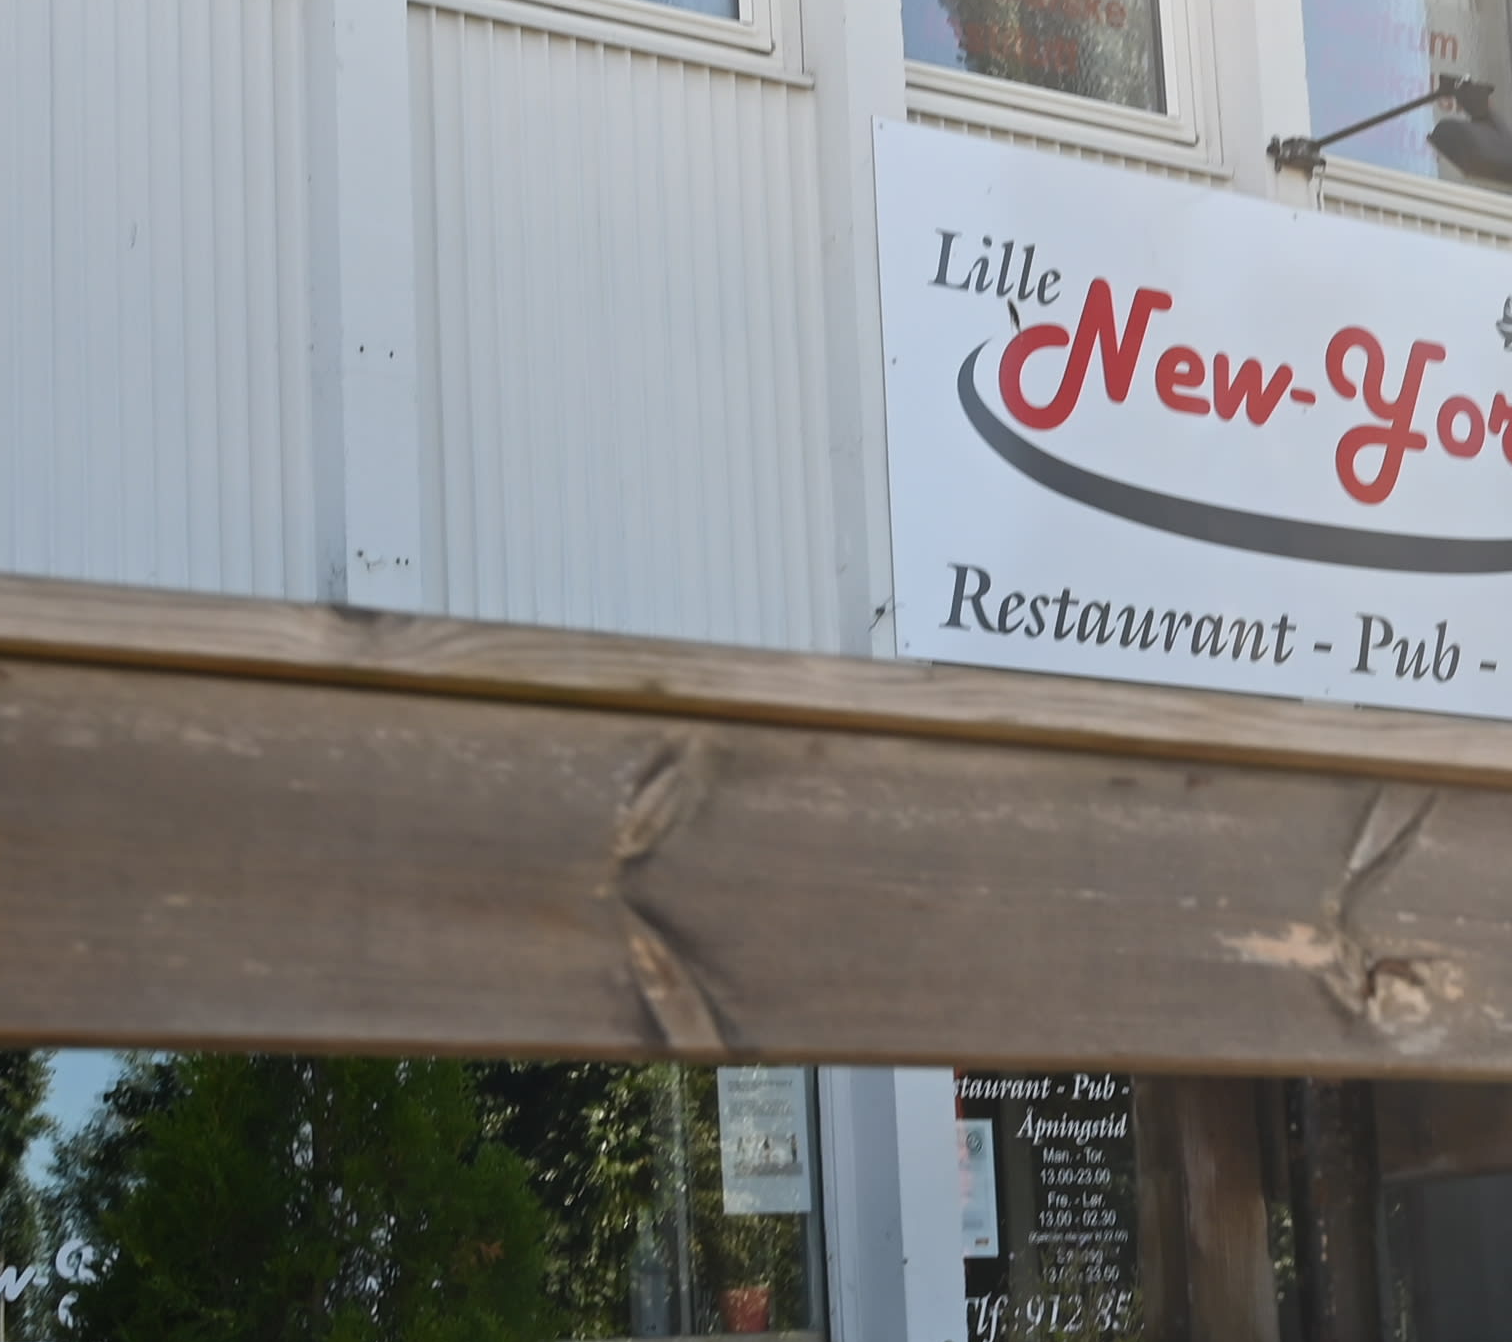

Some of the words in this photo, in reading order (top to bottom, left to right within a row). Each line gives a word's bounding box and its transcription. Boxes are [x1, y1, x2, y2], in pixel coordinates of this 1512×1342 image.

[928, 228, 1063, 307] Lille
[940, 562, 1297, 665] Restaurant
[1350, 612, 1463, 684] Pub
[1072, 1073, 1116, 1101] Pub
[1016, 1105, 1128, 1146] Åpningstid
[1039, 1210, 1072, 1228] 13.00
[1082, 1209, 1117, 1227] 02.30
